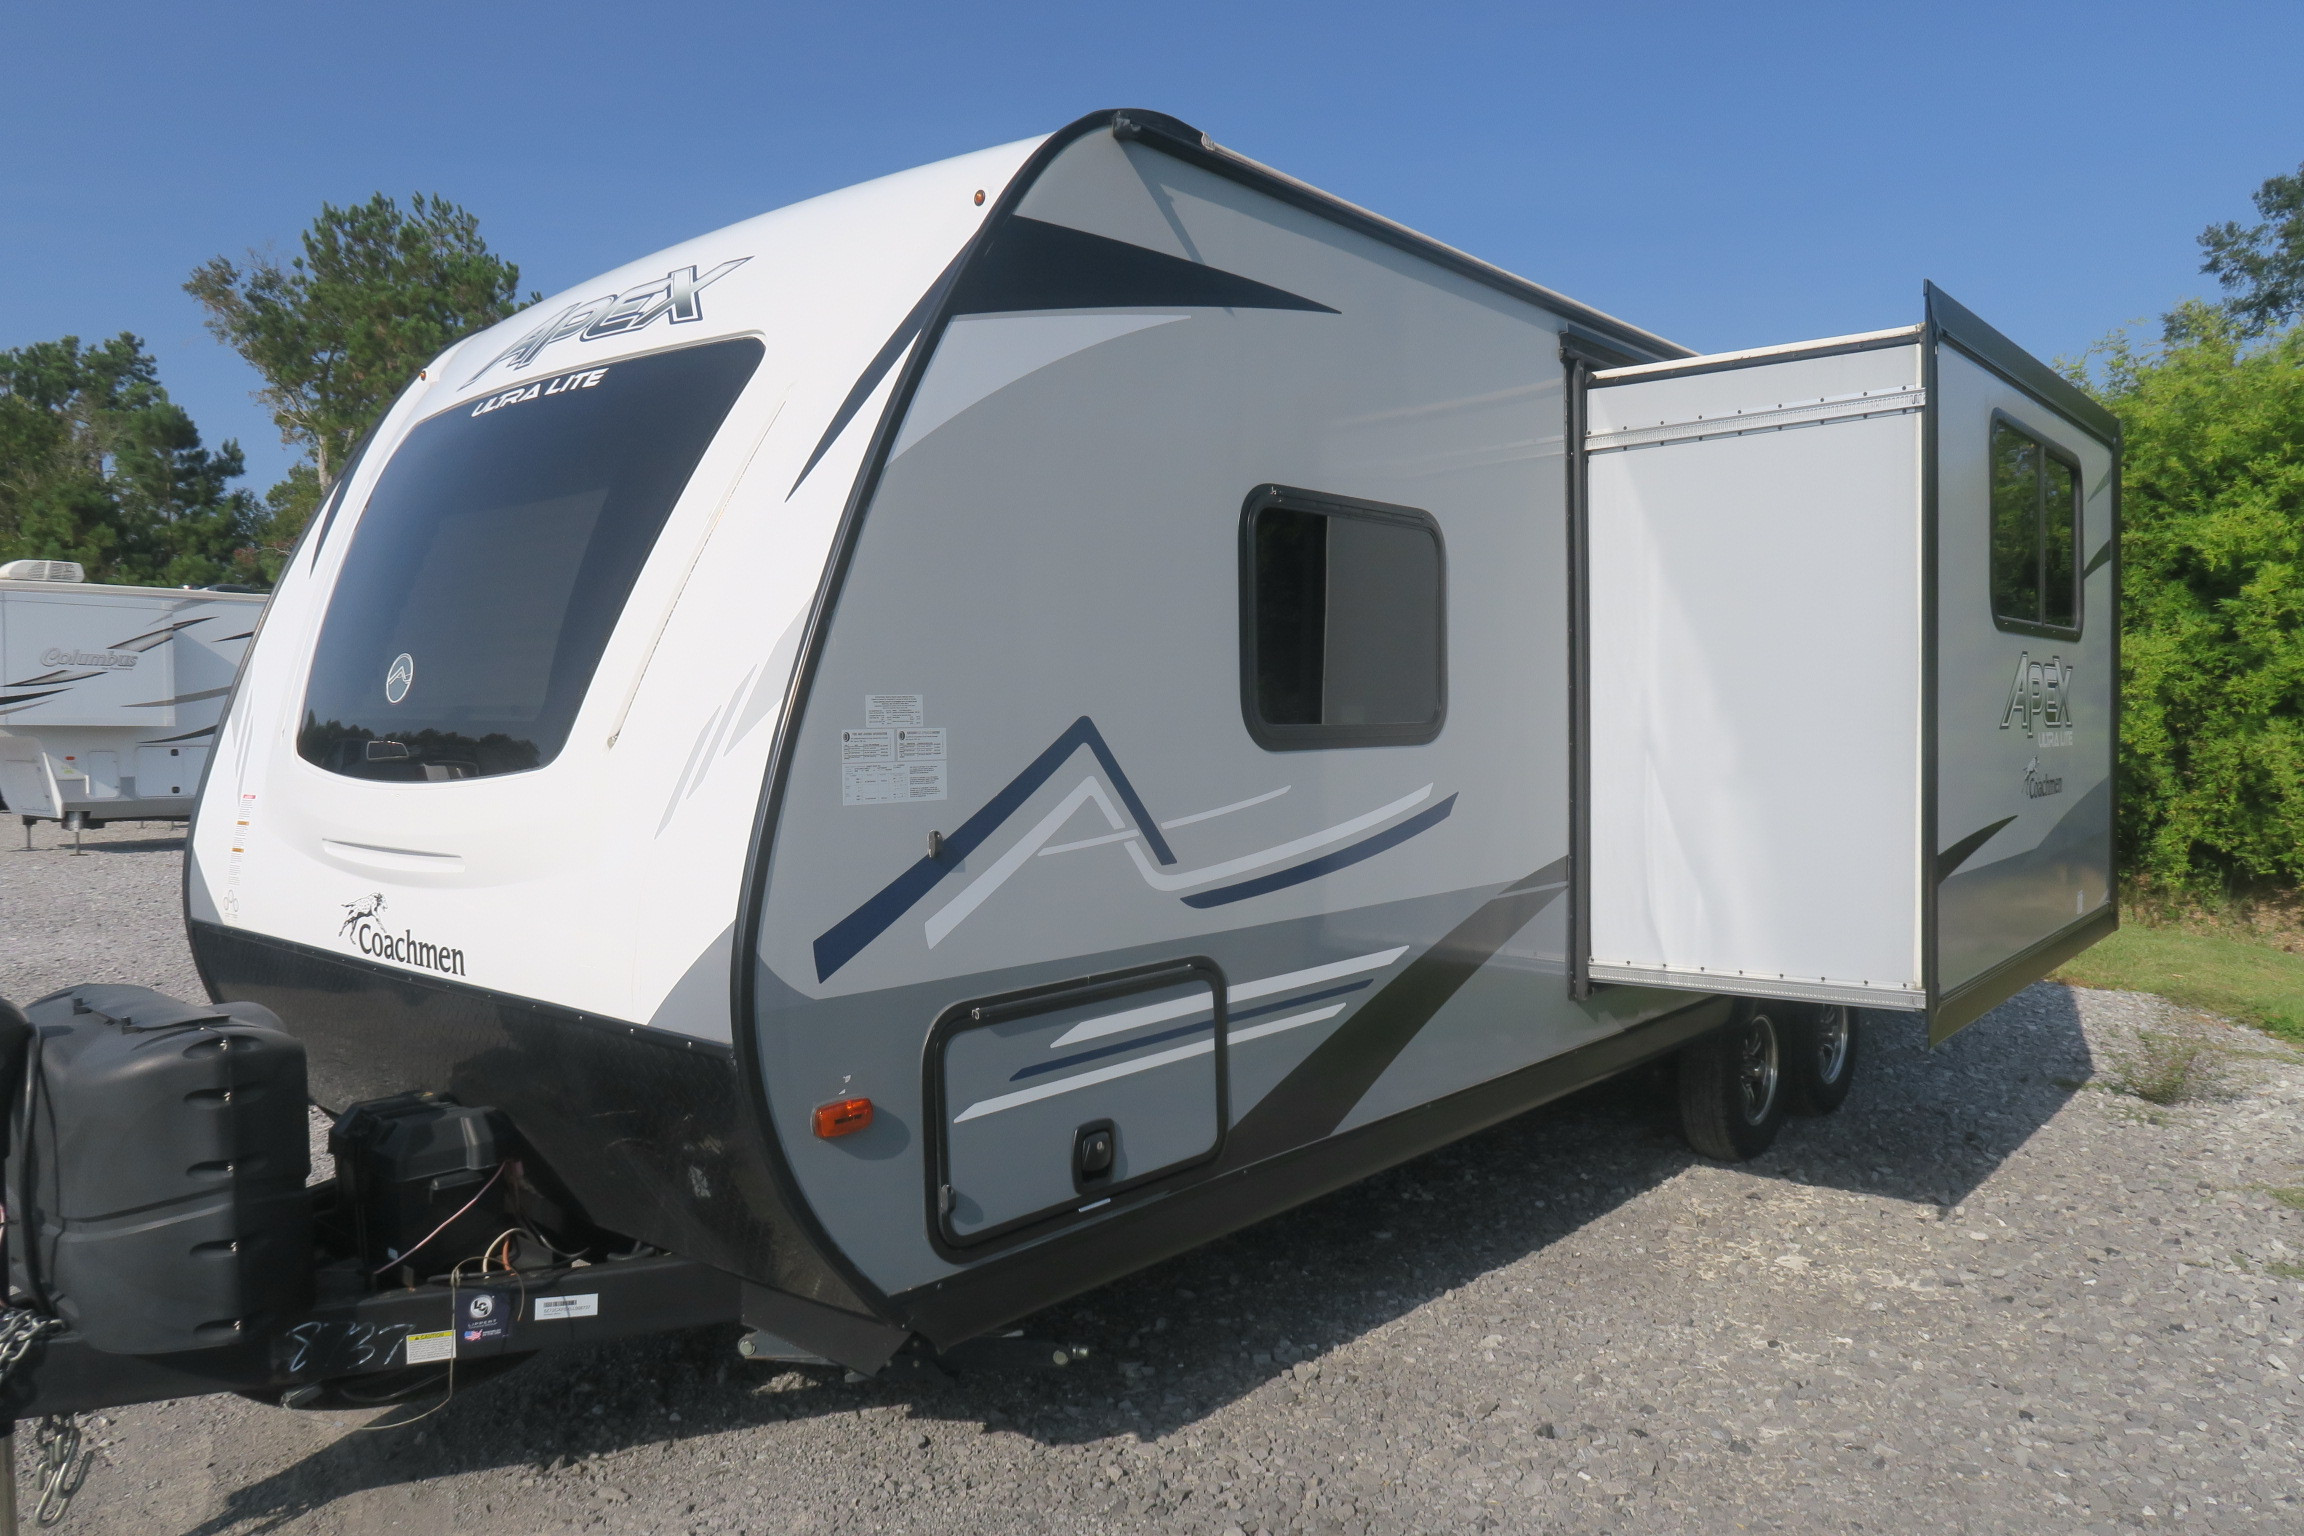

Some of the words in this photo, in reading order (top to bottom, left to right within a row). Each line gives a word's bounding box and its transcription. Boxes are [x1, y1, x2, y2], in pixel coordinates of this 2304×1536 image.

[456, 255, 756, 392] APEX
[471, 382, 542, 418] ULTRA
[543, 367, 609, 396] LITE
[40, 648, 139, 668] Columbus
[1999, 650, 2073, 738] APEX
[2038, 731, 2059, 748] ULTRA
[2060, 730, 2073, 747] LITE
[358, 923, 466, 977] Coachmen
